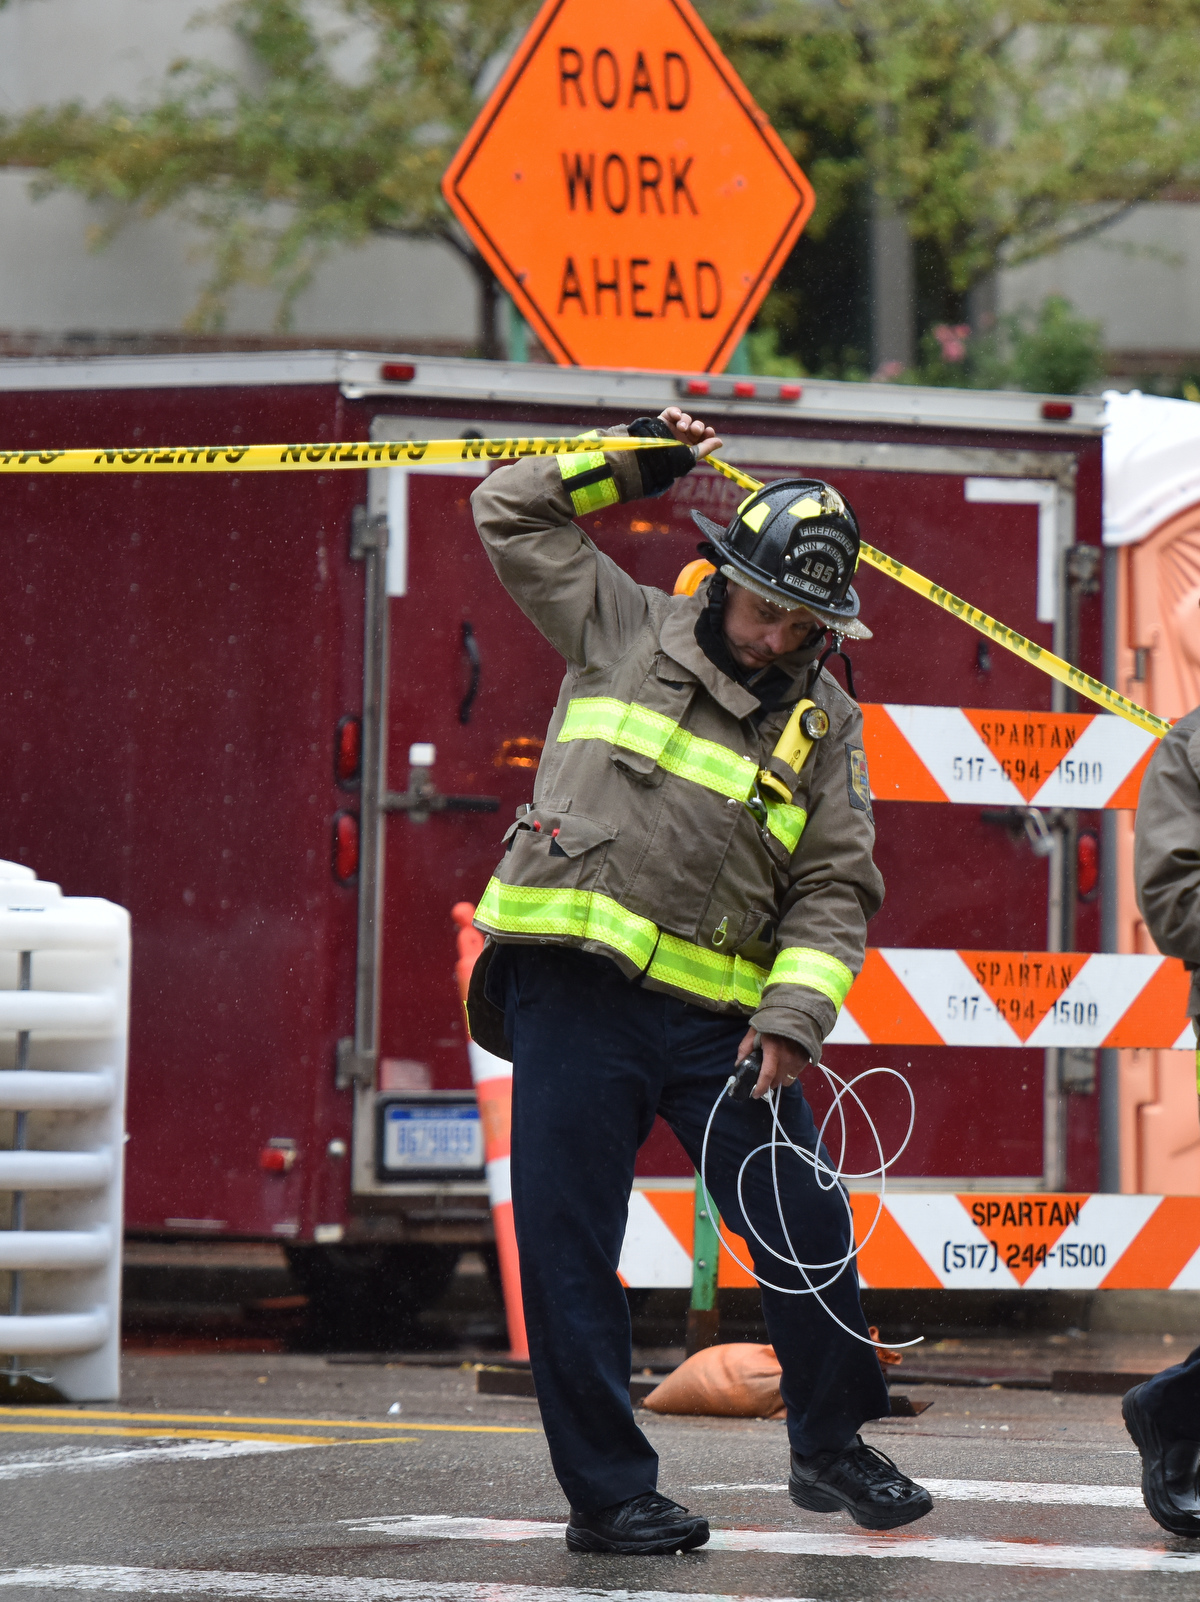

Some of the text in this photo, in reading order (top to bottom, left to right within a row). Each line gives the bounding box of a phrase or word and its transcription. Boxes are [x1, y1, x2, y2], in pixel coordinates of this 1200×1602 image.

[558, 47, 691, 111] ROAD
[562, 152, 699, 215] WORK
[557, 256, 722, 319] AHEAD
[802, 526, 853, 555] FIREFIGHTER
[797, 542, 817, 554] ANN
[821, 543, 845, 569] ARBOR
[801, 557, 834, 583] 195
[787, 574, 831, 598] FIRE DEPT
[980, 723, 1076, 749] SPARTAN
[953, 756, 1103, 785] 517-694-1500
[975, 962, 1073, 989] SPARTAN
[947, 996, 1099, 1025] 517-694-1500
[972, 1201, 1080, 1227] SPARTAN
[943, 1240, 1107, 1274] (517) 244-1500
